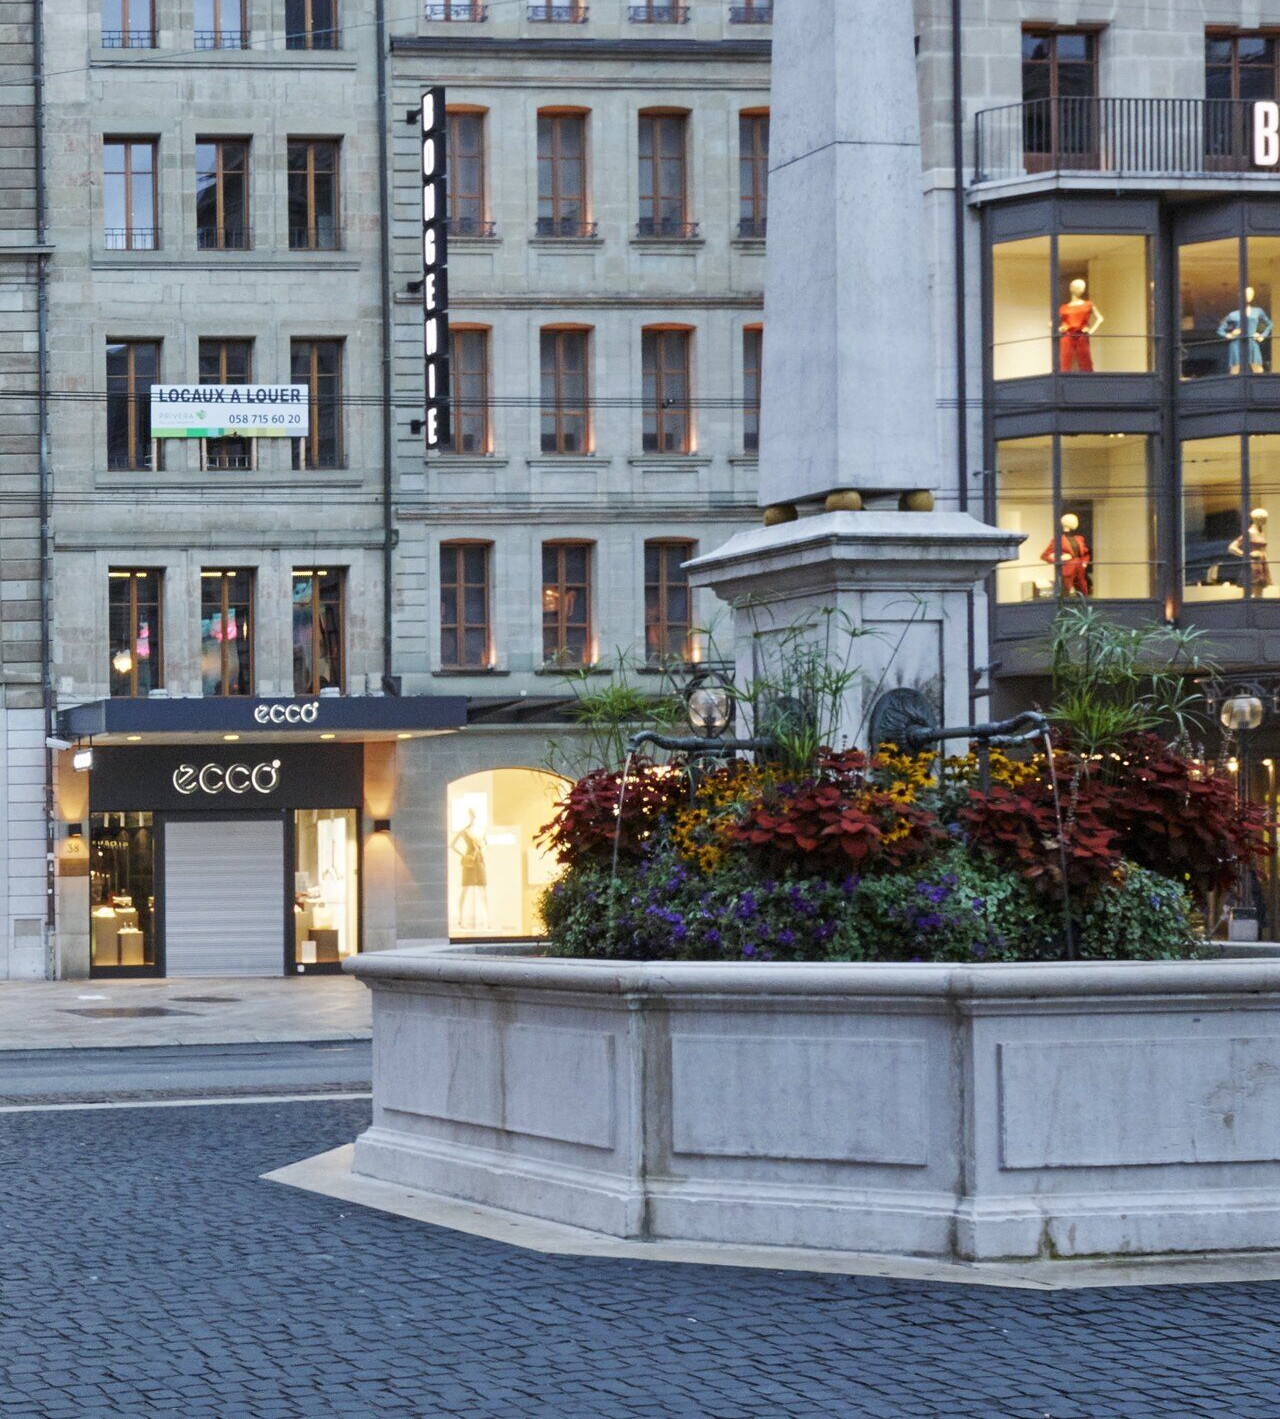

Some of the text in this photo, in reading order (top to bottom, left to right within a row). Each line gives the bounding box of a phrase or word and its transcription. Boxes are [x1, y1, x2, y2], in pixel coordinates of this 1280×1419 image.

[423, 92, 438, 446] BONGENIE
[159, 388, 224, 403] LOCAUX
[247, 388, 301, 403] LOUER
[229, 414, 301, 424] 058 715 60 20
[254, 702, 319, 723] ecco
[173, 759, 281, 794] ecco
[67, 843, 80, 854] 38
